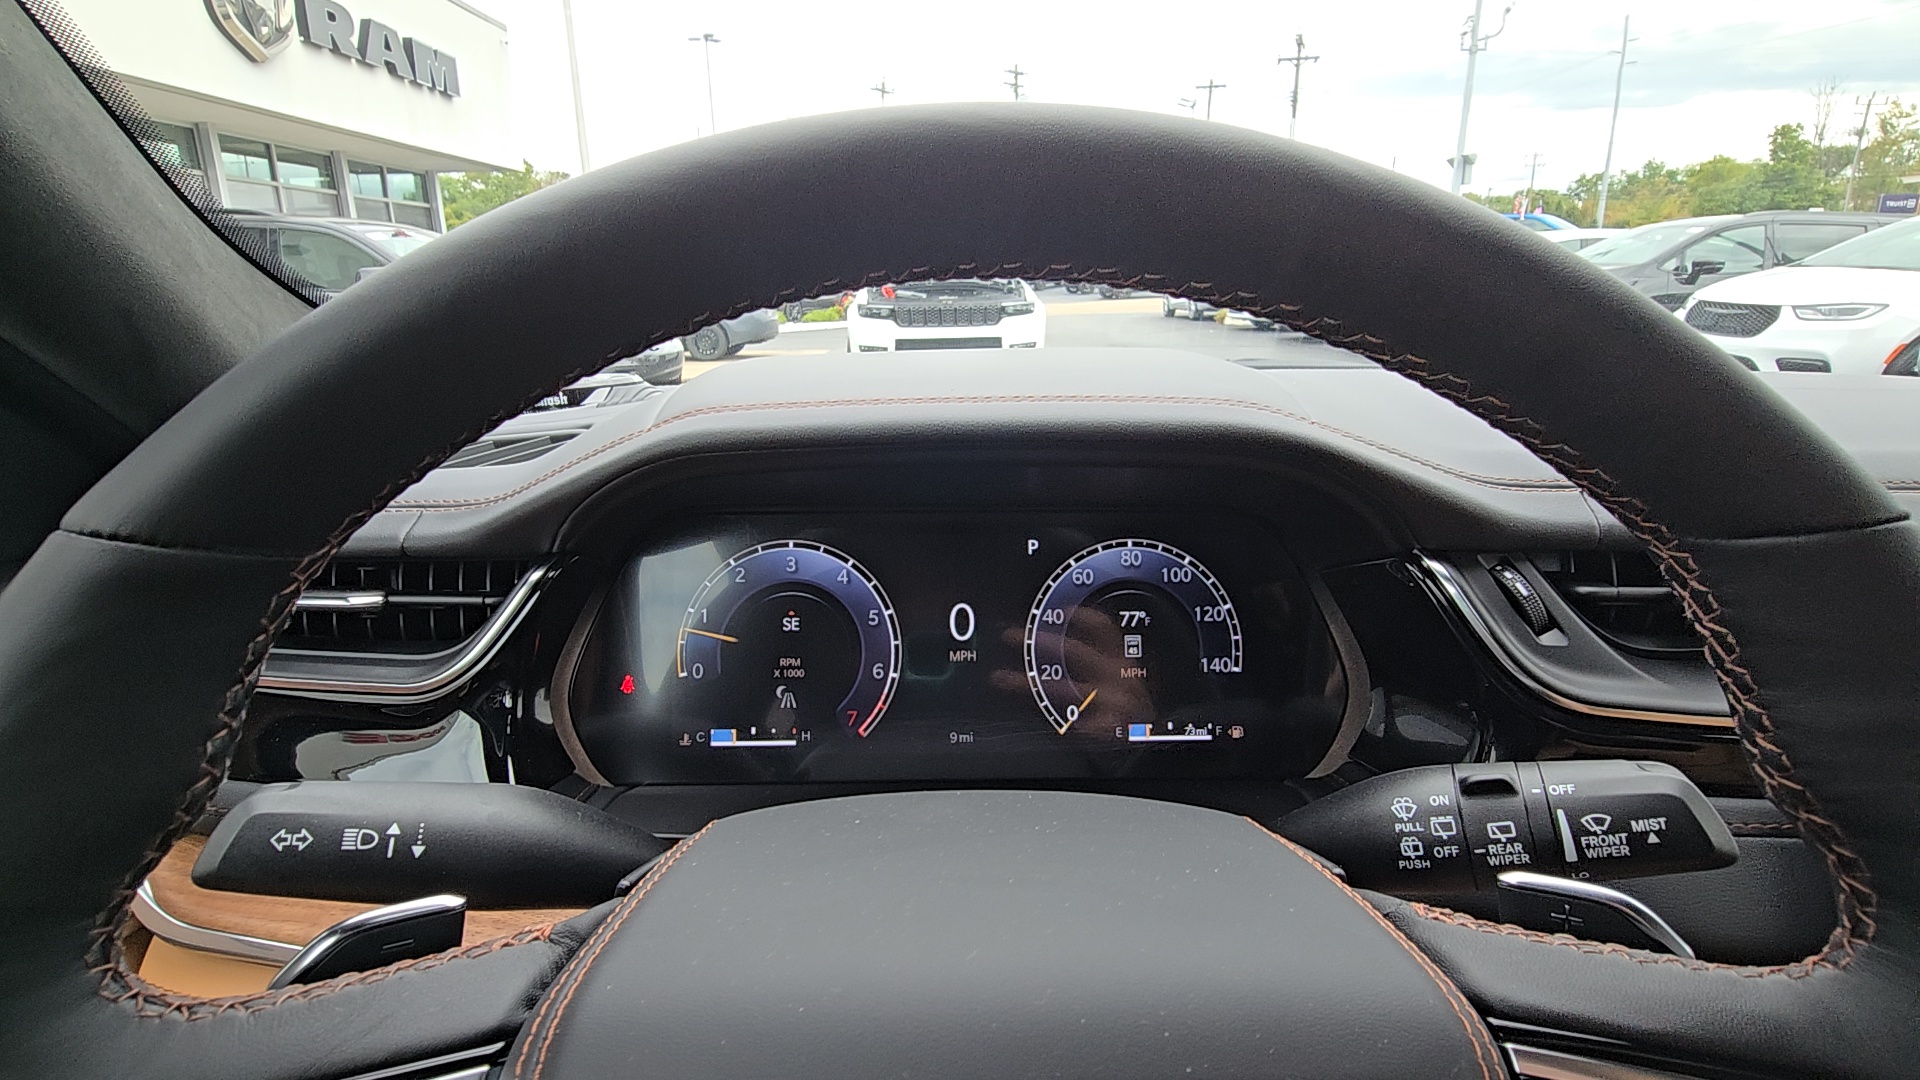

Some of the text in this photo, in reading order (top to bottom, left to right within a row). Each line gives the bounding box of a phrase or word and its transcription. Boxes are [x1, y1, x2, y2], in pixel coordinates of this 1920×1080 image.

[295, 0, 461, 99] RAM
[1027, 539, 1039, 555] P
[785, 556, 797, 572] 3
[1120, 550, 1142, 567] 80
[734, 567, 747, 584] 2
[836, 569, 849, 585] 4
[1071, 568, 1094, 585] 60
[1161, 567, 1192, 584] 100
[700, 608, 709, 624] 1
[867, 609, 880, 626] 5
[1042, 608, 1065, 625] 40
[1194, 605, 1225, 622] 120
[782, 617, 801, 632] SE
[949, 602, 976, 641] 0
[779, 657, 801, 668] RPM
[949, 650, 977, 662] MPH
[692, 662, 704, 679] 0
[773, 668, 805, 678] X 1000
[872, 662, 885, 679] 6
[1040, 664, 1063, 681] 20
[1120, 667, 1147, 679] MPH
[1200, 657, 1231, 674] 140
[846, 710, 859, 727] 7
[1066, 704, 1079, 722] 0
[695, 731, 706, 743] C
[801, 730, 811, 742] H
[1115, 726, 1123, 738] E
[1215, 726, 1223, 737] F
[1549, 783, 1576, 796] OFF
[1429, 795, 1450, 806] ON
[1395, 821, 1425, 833] PULL
[1631, 817, 1668, 832] MIST
[1580, 833, 1629, 848] FRONT
[1433, 845, 1460, 859] OFF
[1488, 843, 1524, 855] REAR
[1584, 845, 1632, 859] WIPER
[1398, 860, 1431, 870] PUSH
[1487, 854, 1532, 867] WIPER
